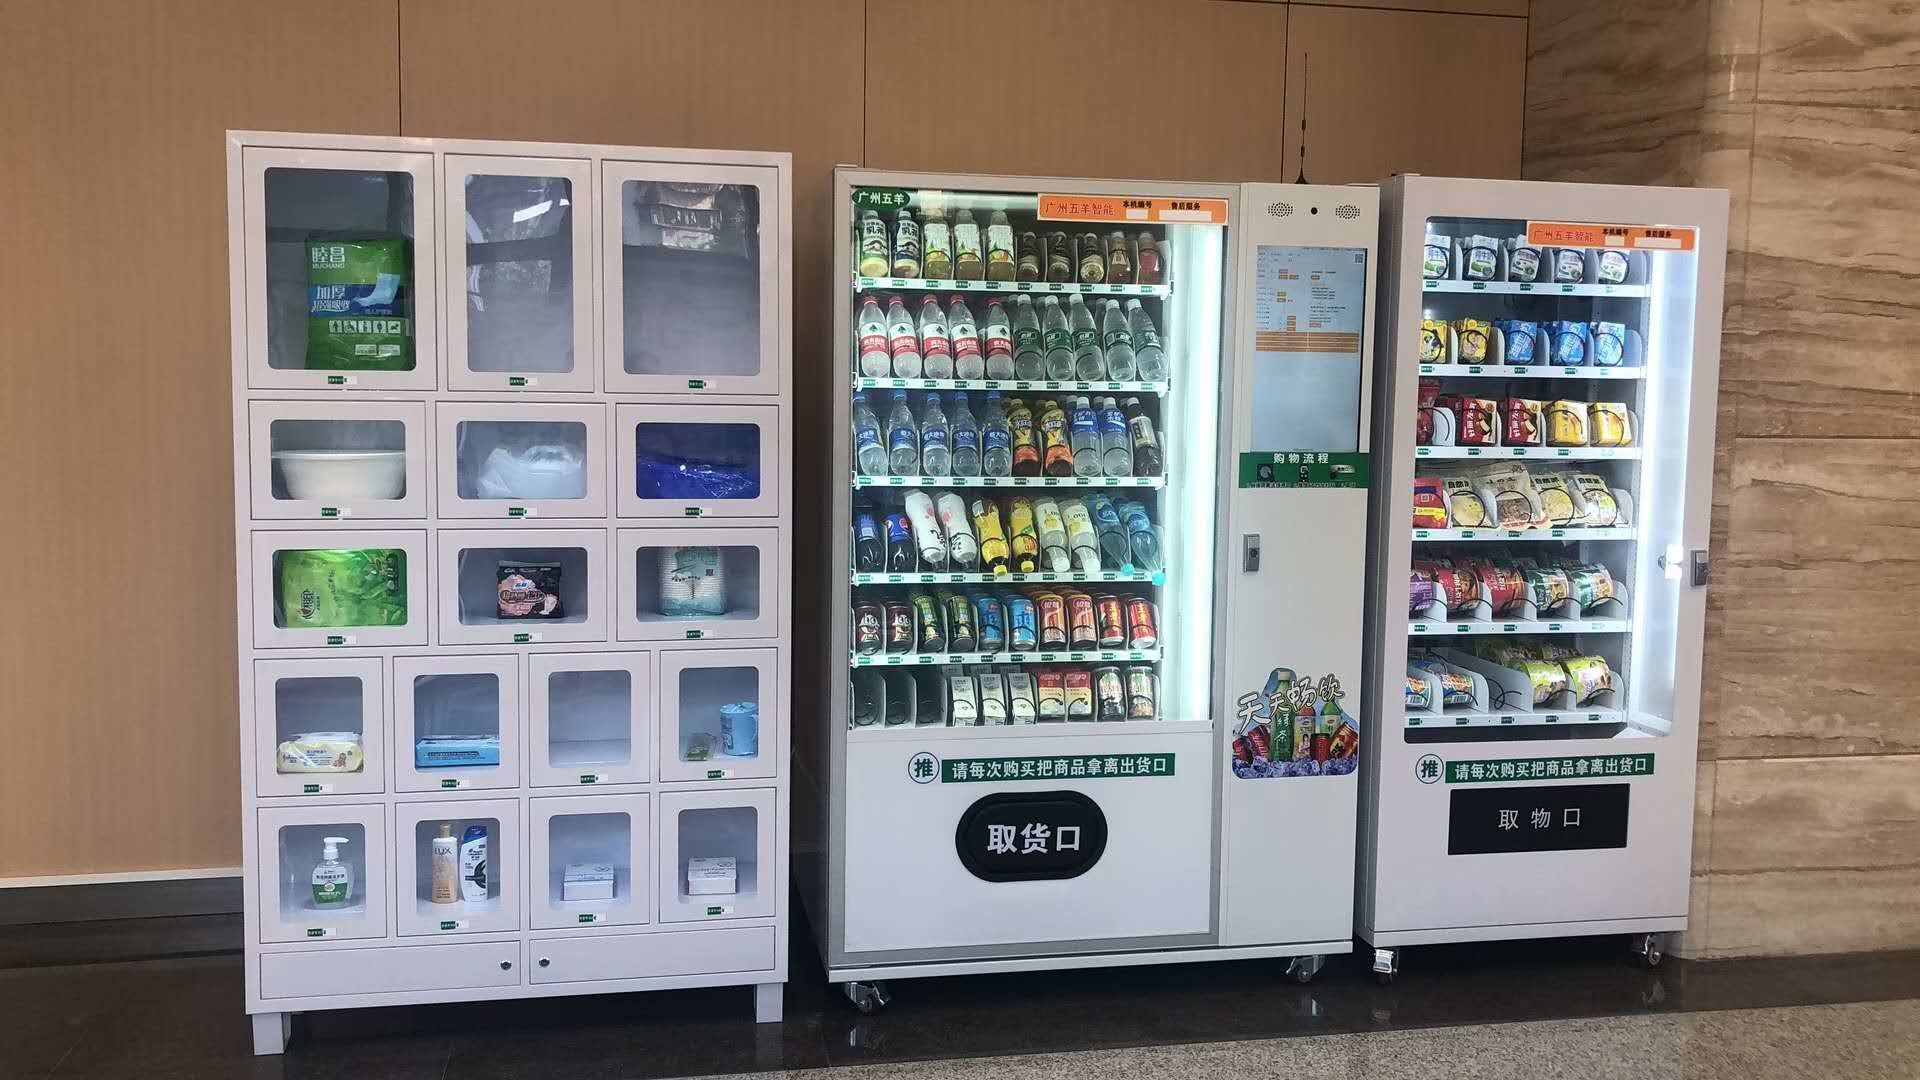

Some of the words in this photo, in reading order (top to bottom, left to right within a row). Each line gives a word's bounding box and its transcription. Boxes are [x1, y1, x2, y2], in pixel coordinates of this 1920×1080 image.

[857, 192, 905, 206] 广州五羊
[1122, 199, 1153, 209] 本机编号
[1170, 202, 1201, 211] 售后服务
[1044, 202, 1114, 217] 广州五羊智能
[1533, 229, 1594, 243] 广州五羊智能
[311, 246, 346, 263] 睦昌
[316, 284, 346, 301] 加厚
[1273, 453, 1329, 464] 购物流程
[1238, 676, 1343, 736] 天天畅饮
[913, 757, 935, 779] 推
[951, 757, 1168, 781] 请每次购买把商品拿离出货口
[1420, 759, 1439, 779] 推
[1454, 756, 1648, 781] 请每次购买把商品拿离出货口
[1497, 807, 1582, 831] 取物口
[986, 821, 1082, 855] 取货口
[434, 848, 453, 856] LUX
